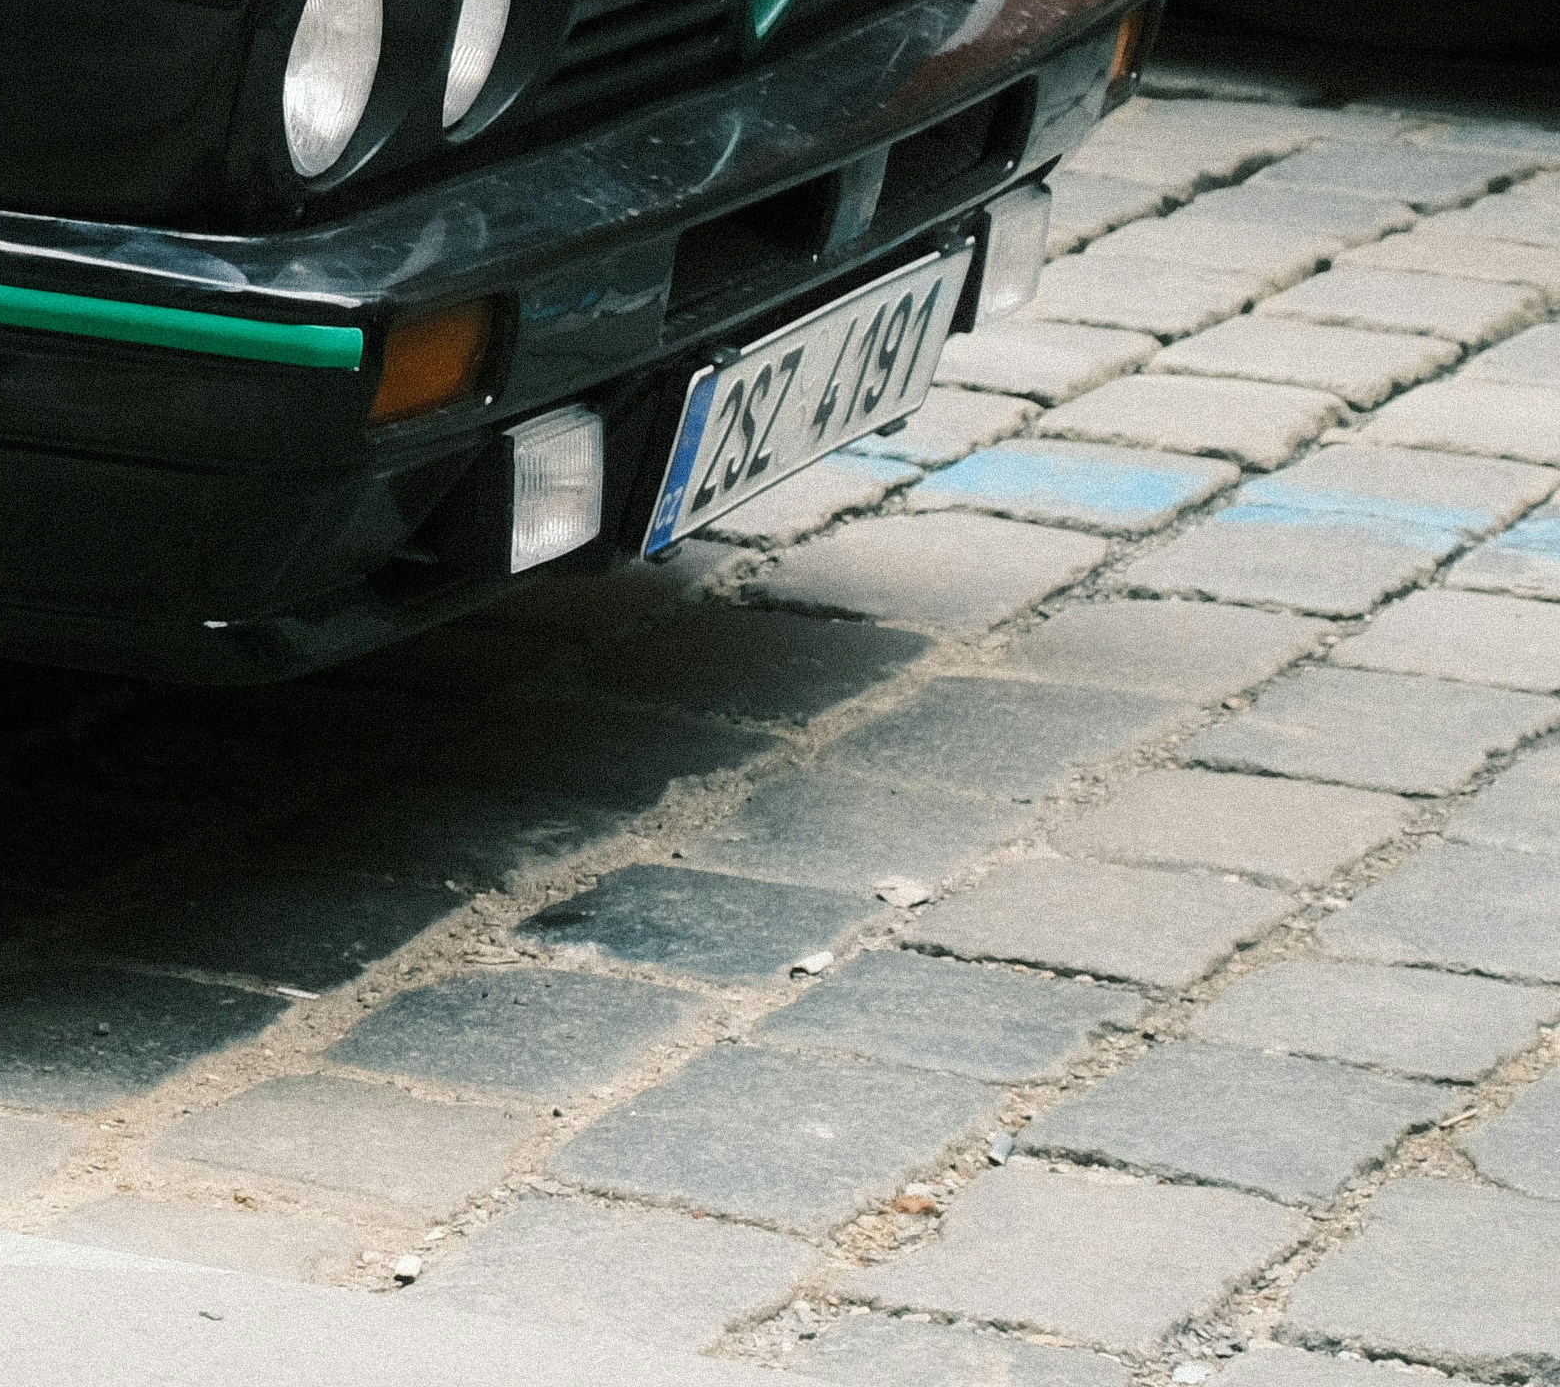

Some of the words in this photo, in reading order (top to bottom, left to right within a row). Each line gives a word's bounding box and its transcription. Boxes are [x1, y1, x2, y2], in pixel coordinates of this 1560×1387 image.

[688, 347, 806, 514] 2SZ
[813, 278, 944, 441] 4191
[654, 487, 685, 530] CZ
